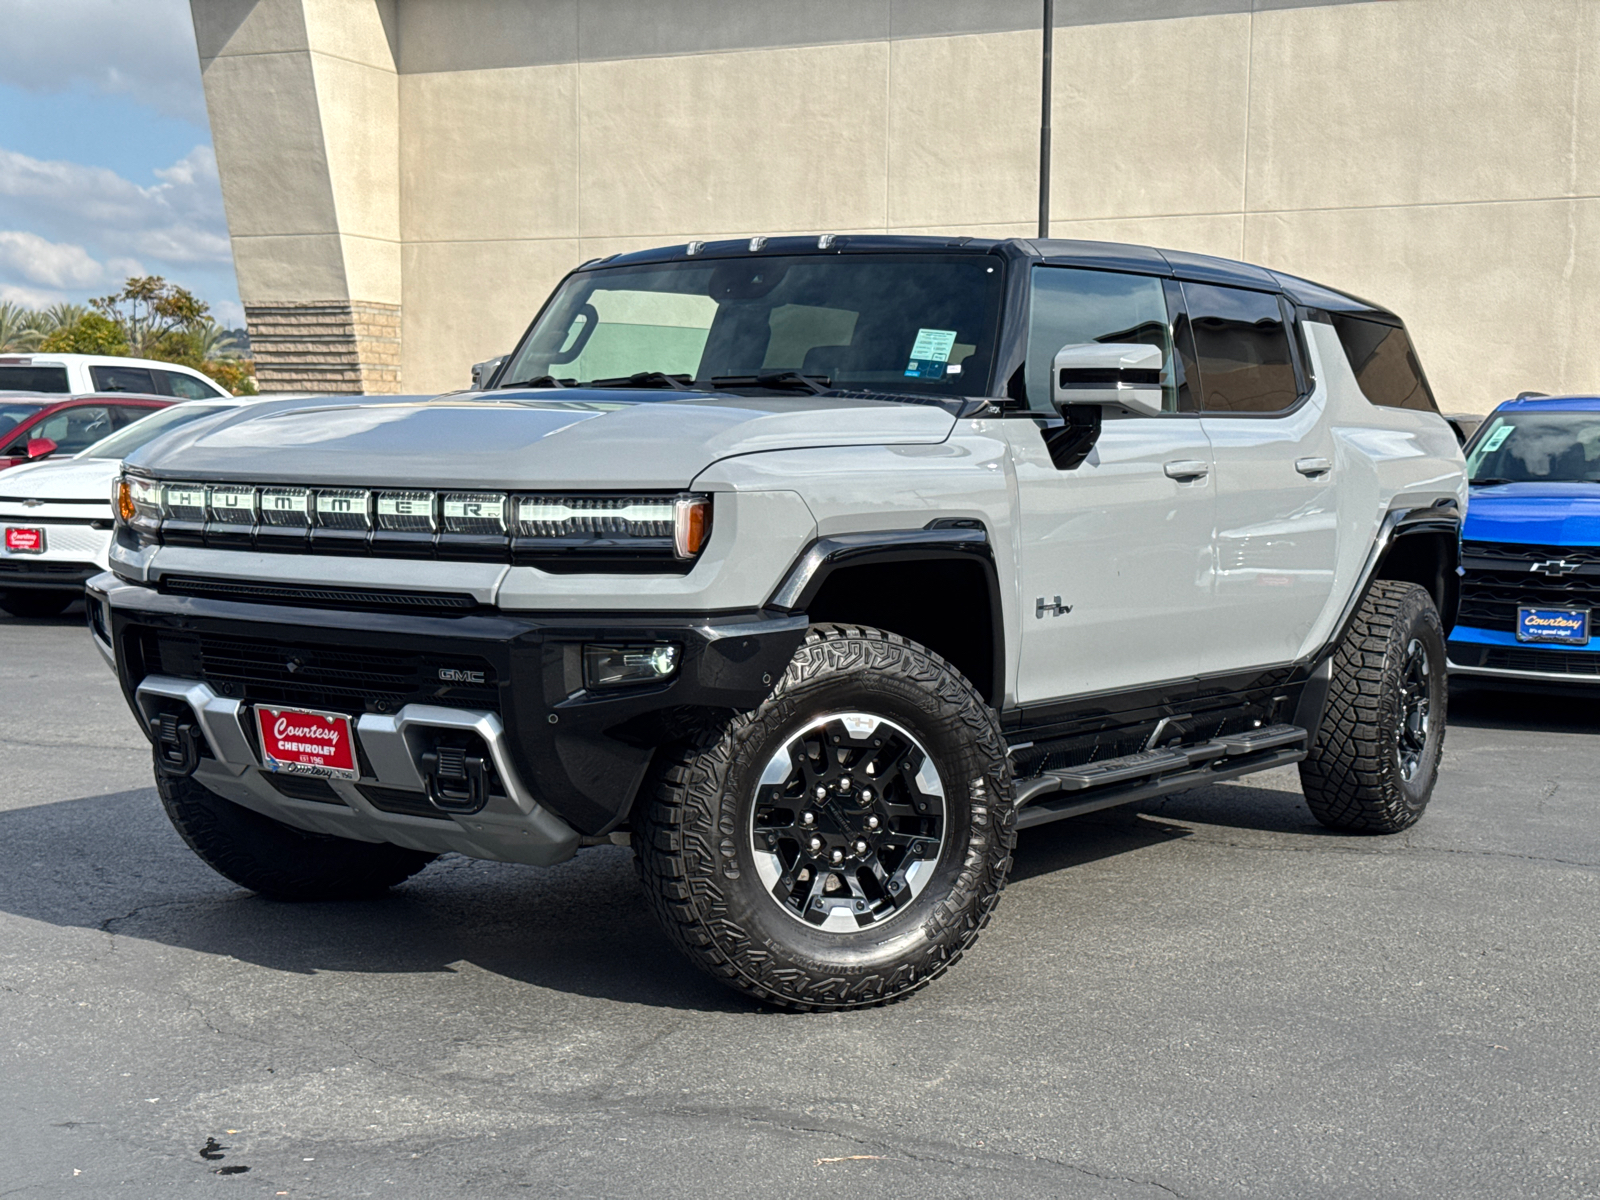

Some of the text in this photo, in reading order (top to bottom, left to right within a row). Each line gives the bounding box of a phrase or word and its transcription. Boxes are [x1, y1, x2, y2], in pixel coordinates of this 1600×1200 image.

[179, 492, 482, 517] HUMMER
[1524, 615, 1582, 629] Courtesy
[438, 668, 485, 683] GMC
[274, 717, 339, 745] Courtesy
[277, 740, 336, 756] CHEVROLET
[288, 762, 333, 779] Courtesy
[719, 699, 796, 880] GOODYEAR
[921, 776, 988, 942] WRANGLER
